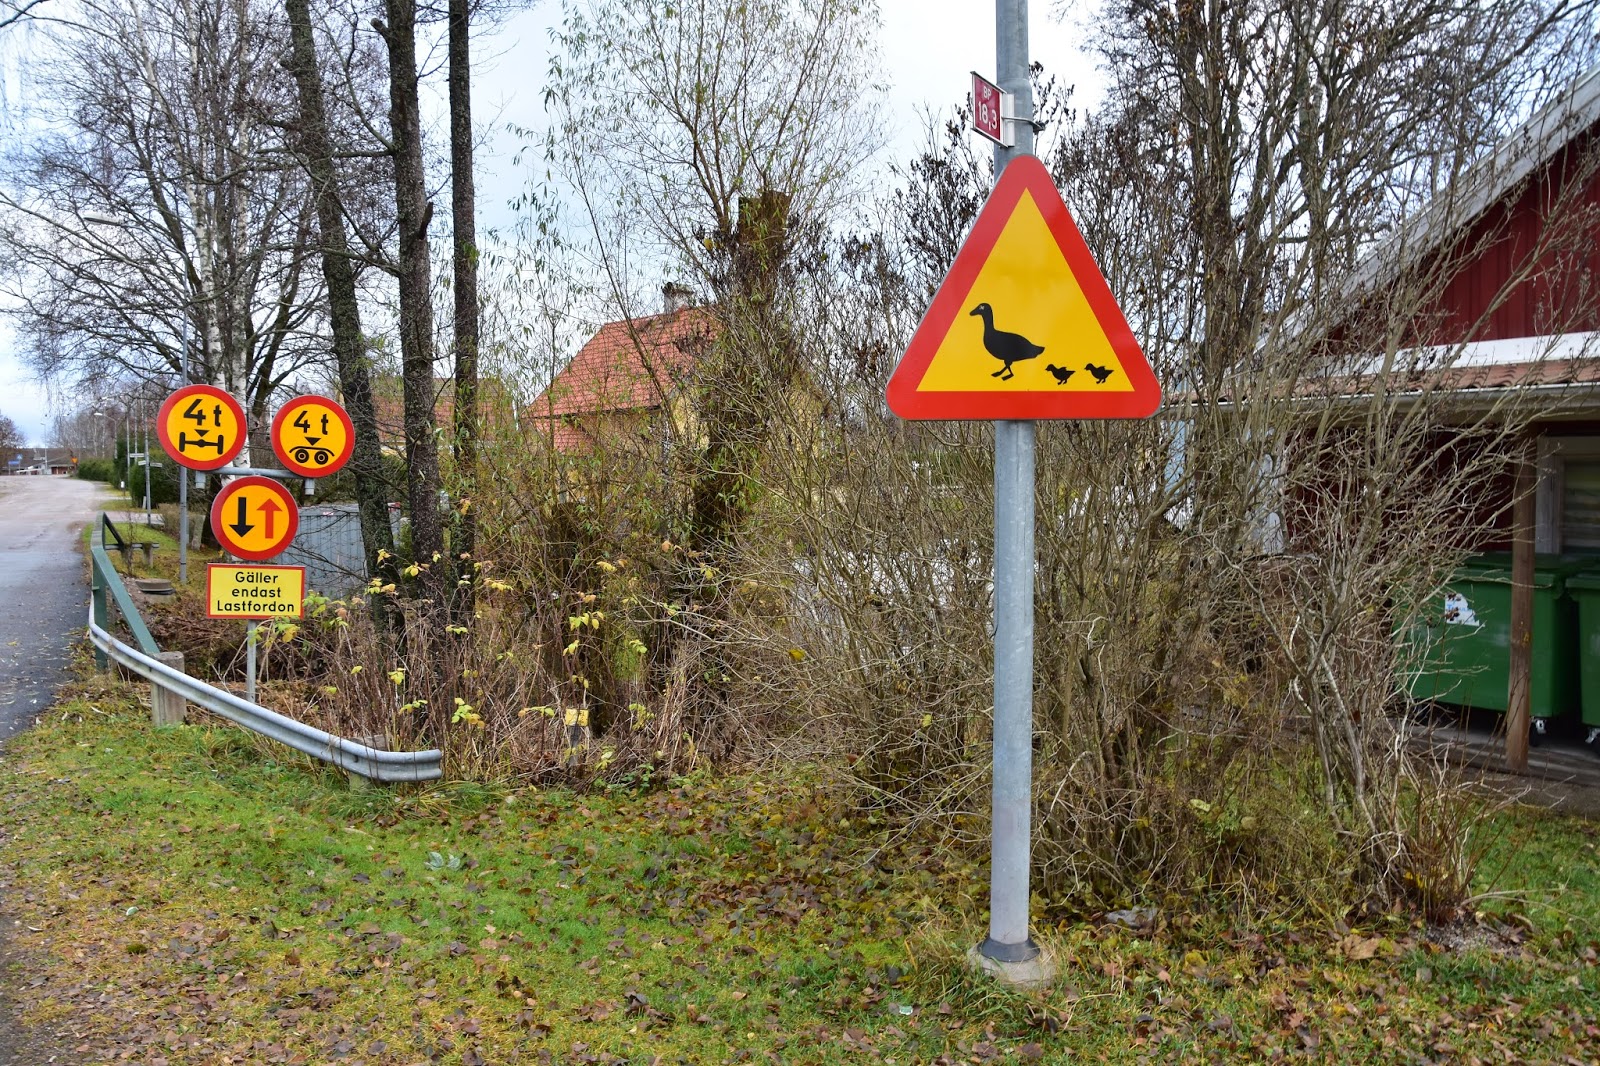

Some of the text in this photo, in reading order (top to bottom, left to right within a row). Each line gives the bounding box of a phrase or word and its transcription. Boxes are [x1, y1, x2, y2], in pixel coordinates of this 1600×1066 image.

[983, 86, 991, 100] BP
[183, 399, 222, 427] 4 t
[294, 411, 329, 435] 4 t
[235, 572, 279, 584] Gäller
[231, 587, 281, 598] endast
[217, 600, 295, 612] Lastfordon
